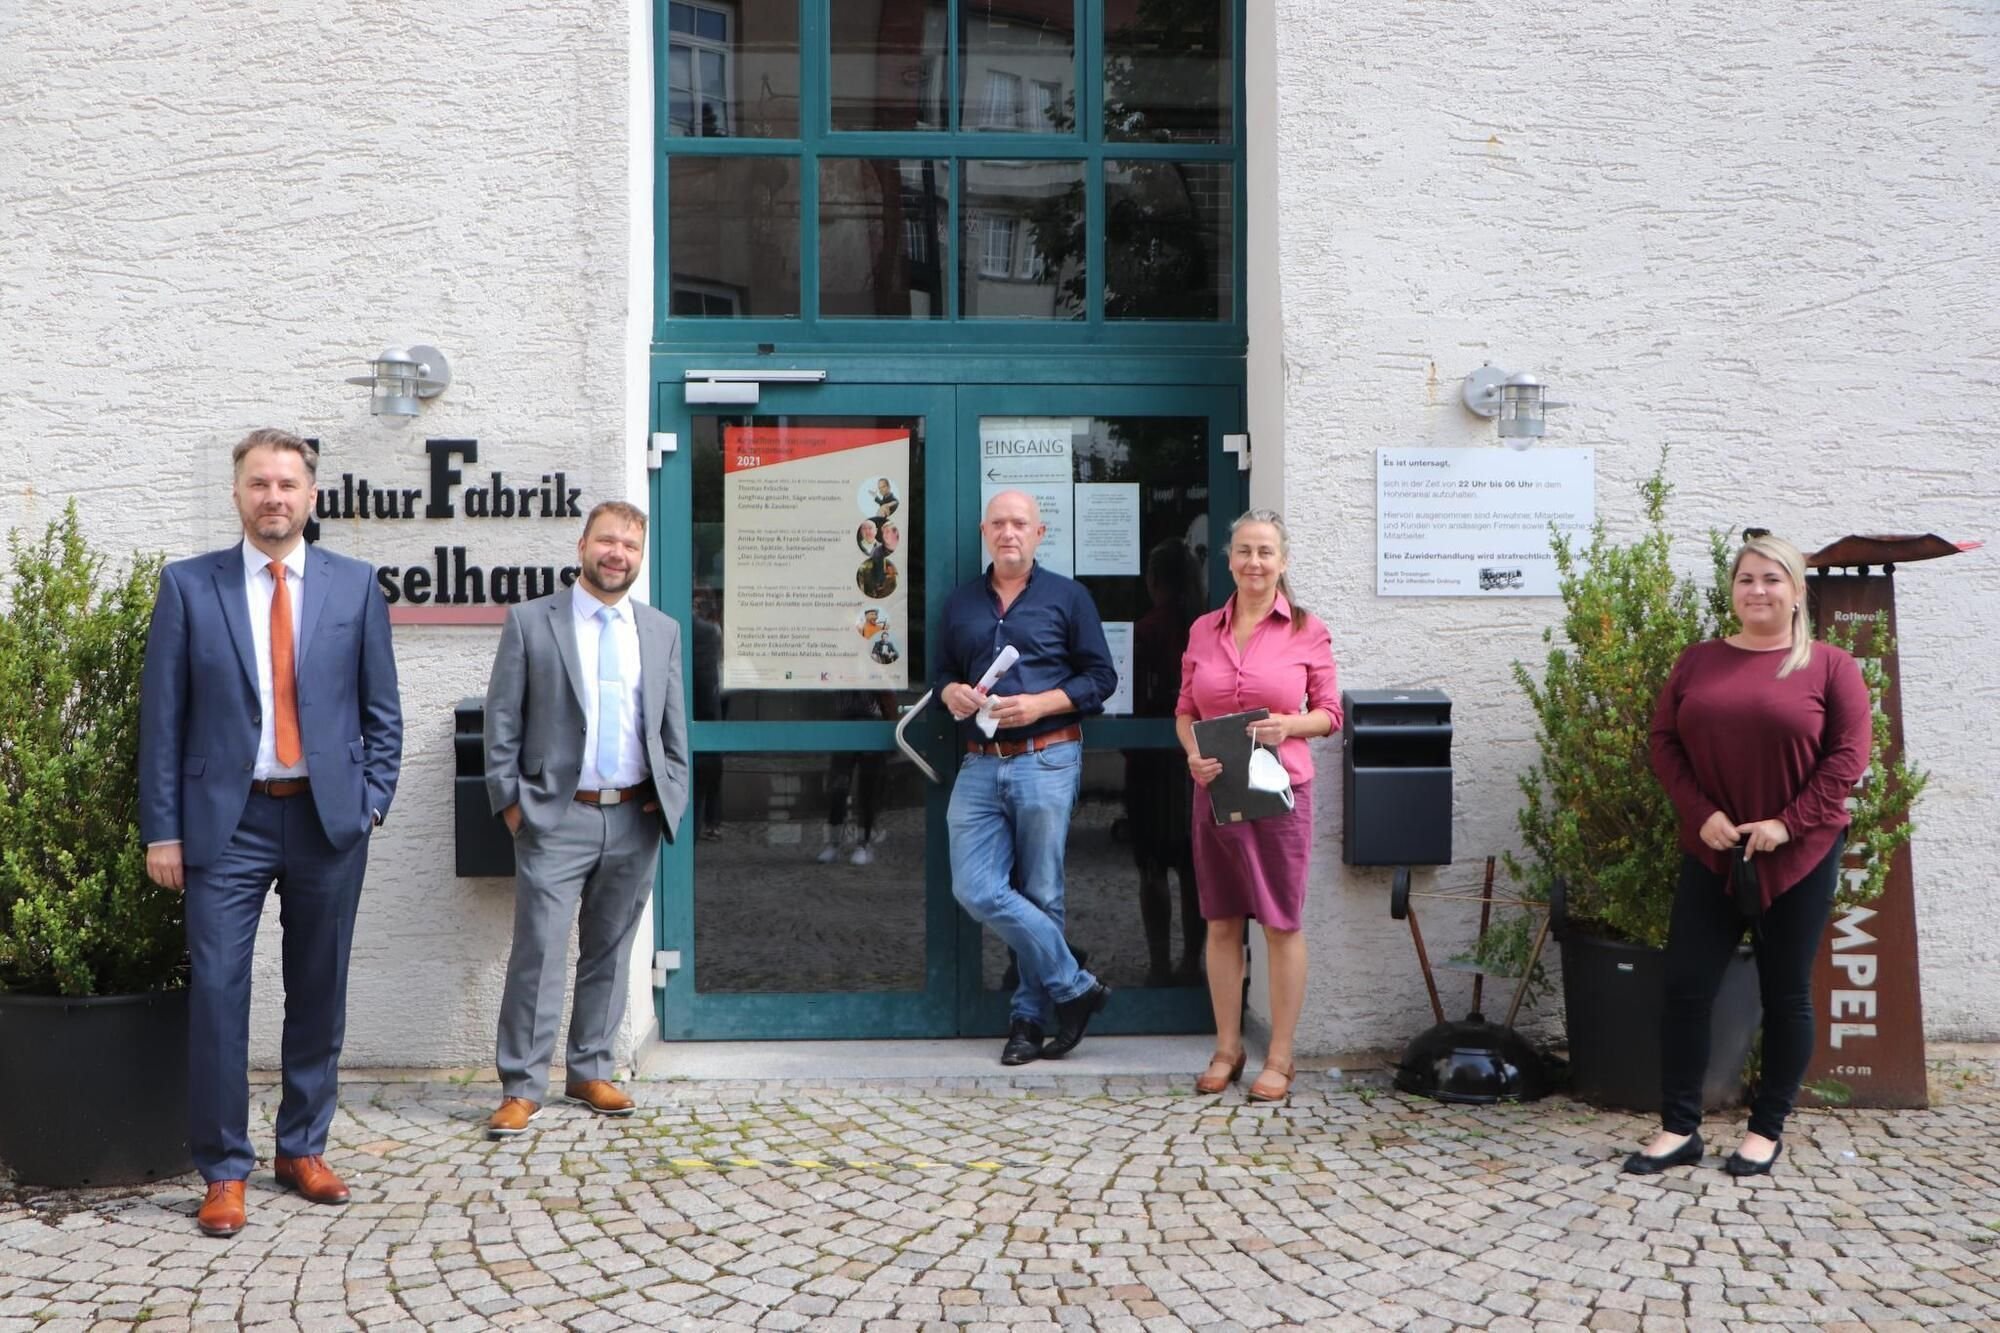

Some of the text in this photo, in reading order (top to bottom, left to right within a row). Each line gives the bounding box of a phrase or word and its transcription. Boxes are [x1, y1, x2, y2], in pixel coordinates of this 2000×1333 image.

[985, 439, 1064, 455] EINGANG
[737, 456, 760, 466] 2021
[1409, 459, 1450, 467] untersagt,
[1383, 480, 1398, 488] sich
[1400, 480, 1408, 488] in
[1411, 480, 1422, 488] der
[1425, 480, 1439, 488] Zeit
[1458, 480, 1469, 488] 22
[1472, 480, 1487, 488] Uhr
[1490, 480, 1502, 488] bis
[1505, 480, 1515, 488] 06
[1518, 480, 1533, 488] Uhr
[1536, 480, 1542, 488] in
[1544, 480, 1562, 488] dem
[1474, 512, 1490, 520] sind
[1384, 522, 1398, 530] und
[1401, 522, 1430, 530] Kunden
[1433, 522, 1447, 530] von
[1494, 522, 1520, 530] Firmen
[1522, 522, 1545, 530] sowie
[1404, 552, 1474, 560] Zuwiderhandlung
[1829, 1064, 1872, 1076] .com
